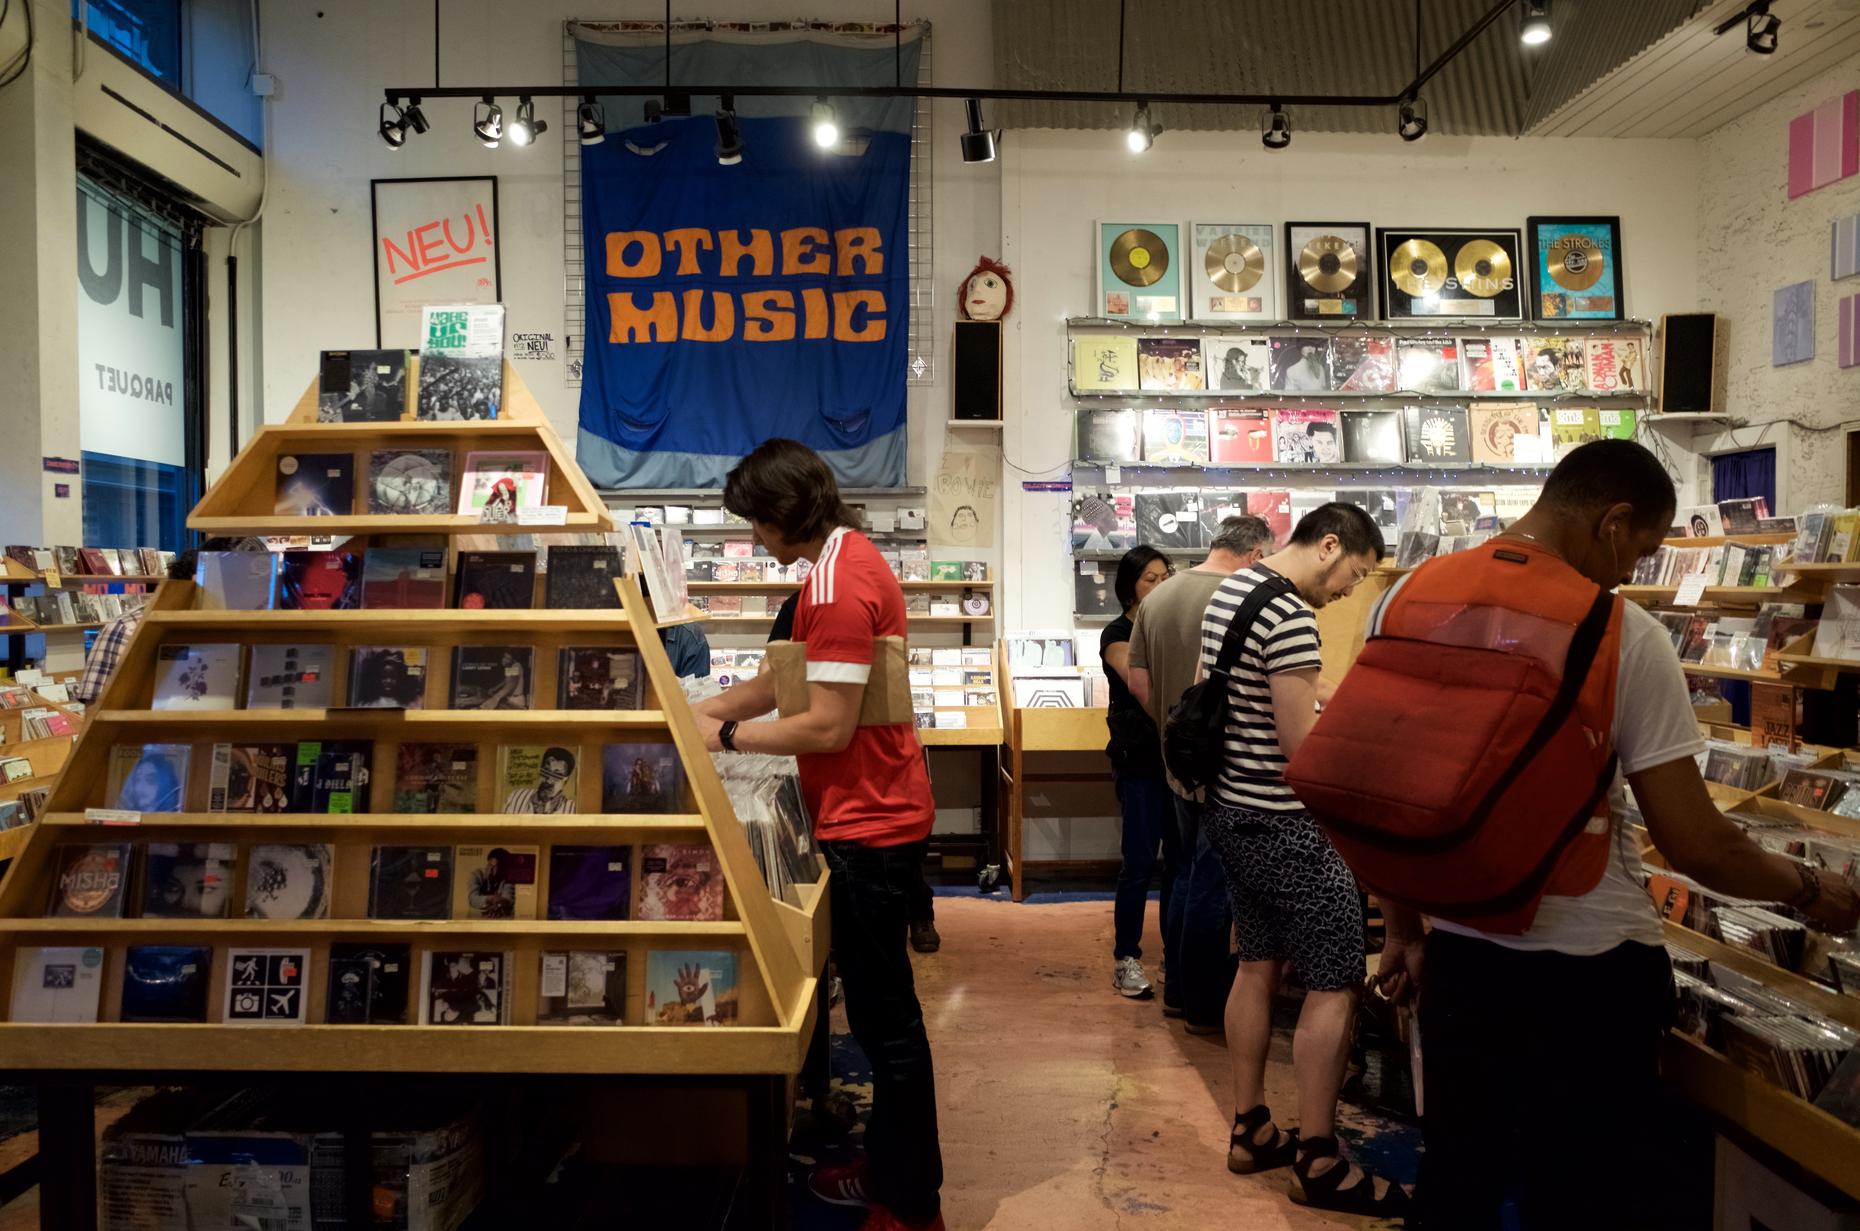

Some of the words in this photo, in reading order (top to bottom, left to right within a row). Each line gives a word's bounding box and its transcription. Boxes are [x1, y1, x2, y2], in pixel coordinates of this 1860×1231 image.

[383, 203, 492, 274] NEU!
[605, 227, 884, 278] OTHER
[606, 288, 888, 343] MUSIC
[512, 333, 554, 343] ORIGINAL
[1764, 721, 1790, 737] JAZZ
[130, 1145, 188, 1163] YAMAHA
